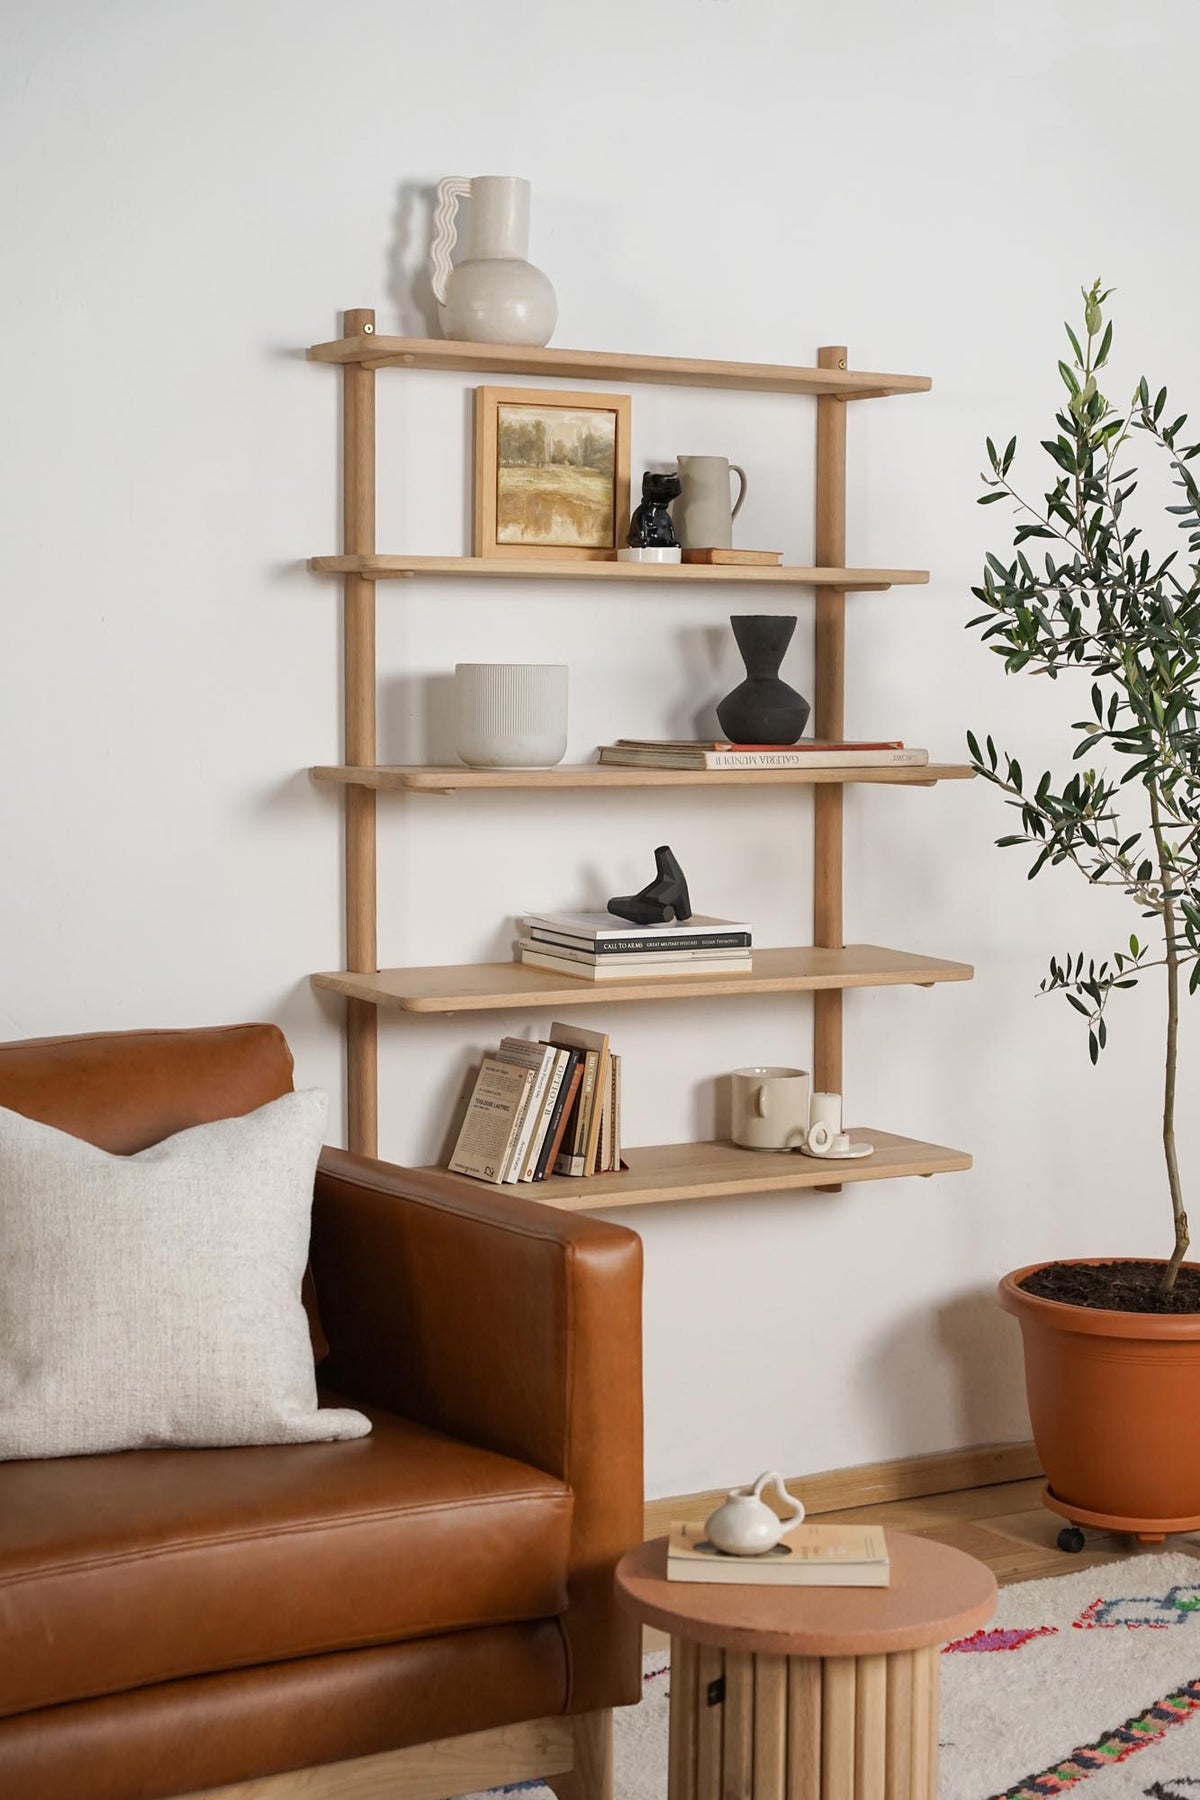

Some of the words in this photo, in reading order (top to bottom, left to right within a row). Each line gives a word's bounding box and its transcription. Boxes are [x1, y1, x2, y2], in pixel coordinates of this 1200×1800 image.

[724, 756, 757, 765] MUNDI
[760, 755, 799, 764] GALERIA
[547, 1064, 564, 1105] OPTION
